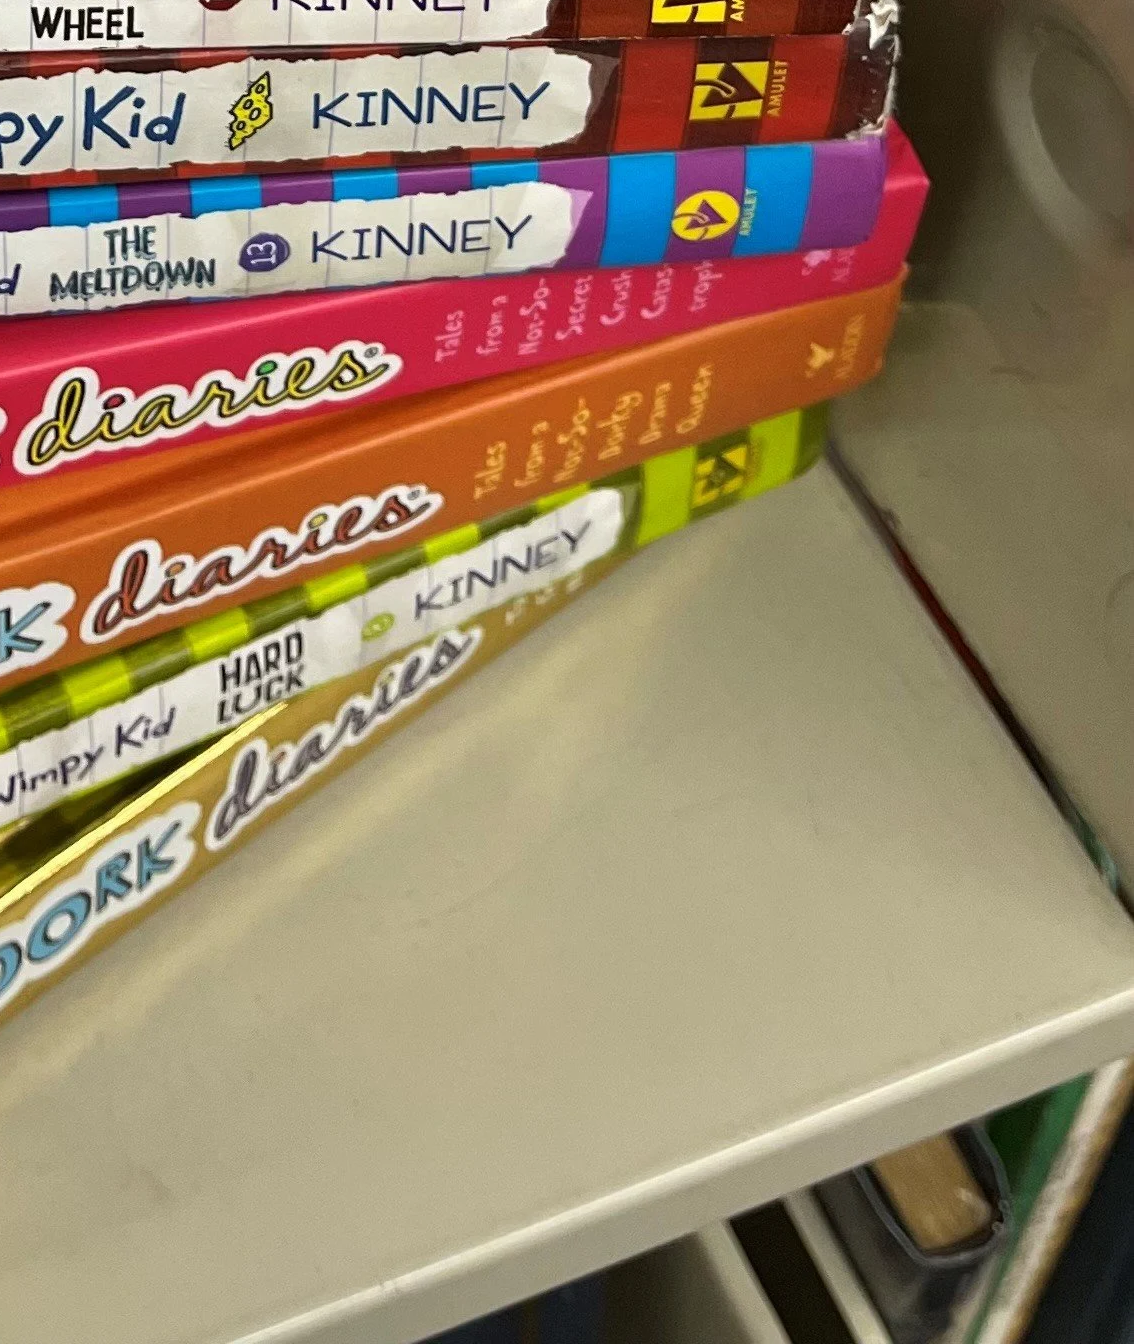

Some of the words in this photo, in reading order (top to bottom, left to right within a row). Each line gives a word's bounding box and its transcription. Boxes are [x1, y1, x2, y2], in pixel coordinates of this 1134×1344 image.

[32, 6, 144, 42] WHEEL
[82, 86, 185, 145] Kid
[311, 81, 551, 129] KINNEY
[767, 59, 790, 118] AMULET
[102, 225, 158, 261] THE
[246, 239, 279, 267] 13
[310, 215, 533, 265] KINNEY
[49, 256, 217, 302] MELTDOWN
[555, 274, 594, 341] Secret
[599, 269, 633, 326] Crush
[434, 309, 465, 363] Tales
[475, 310, 504, 357] from
[28, 347, 391, 467] diaries
[595, 390, 644, 461] Dorky
[637, 381, 673, 446] Drama
[675, 364, 712, 435] Queen
[473, 440, 508, 500] Tales
[513, 439, 545, 488] from
[95, 493, 431, 638] diaries
[413, 520, 593, 620] KINNEY
[218, 630, 304, 694] HARD
[216, 662, 307, 724] LUCK
[113, 706, 178, 759] Kid
